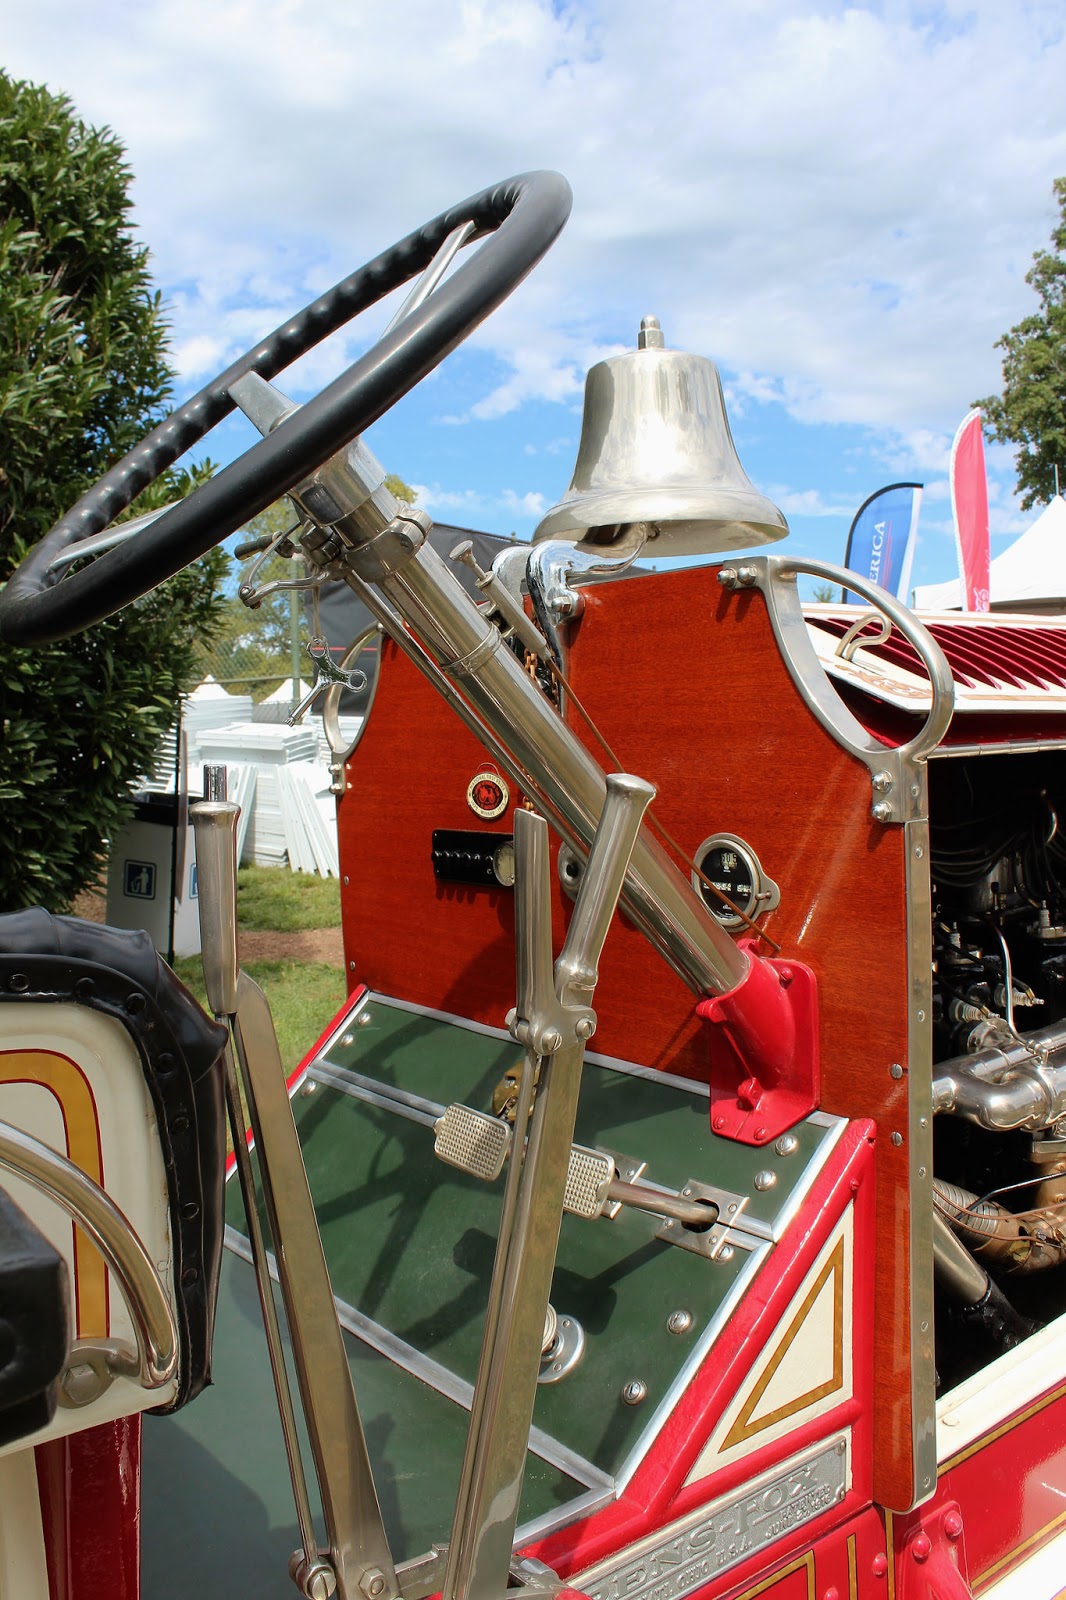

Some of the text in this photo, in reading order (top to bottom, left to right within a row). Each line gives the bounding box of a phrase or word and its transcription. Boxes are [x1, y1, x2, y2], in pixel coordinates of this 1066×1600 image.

[869, 521, 886, 584] ERICA
[765, 1513, 793, 1539] JUNE
[677, 1560, 709, 1590] OHIO
